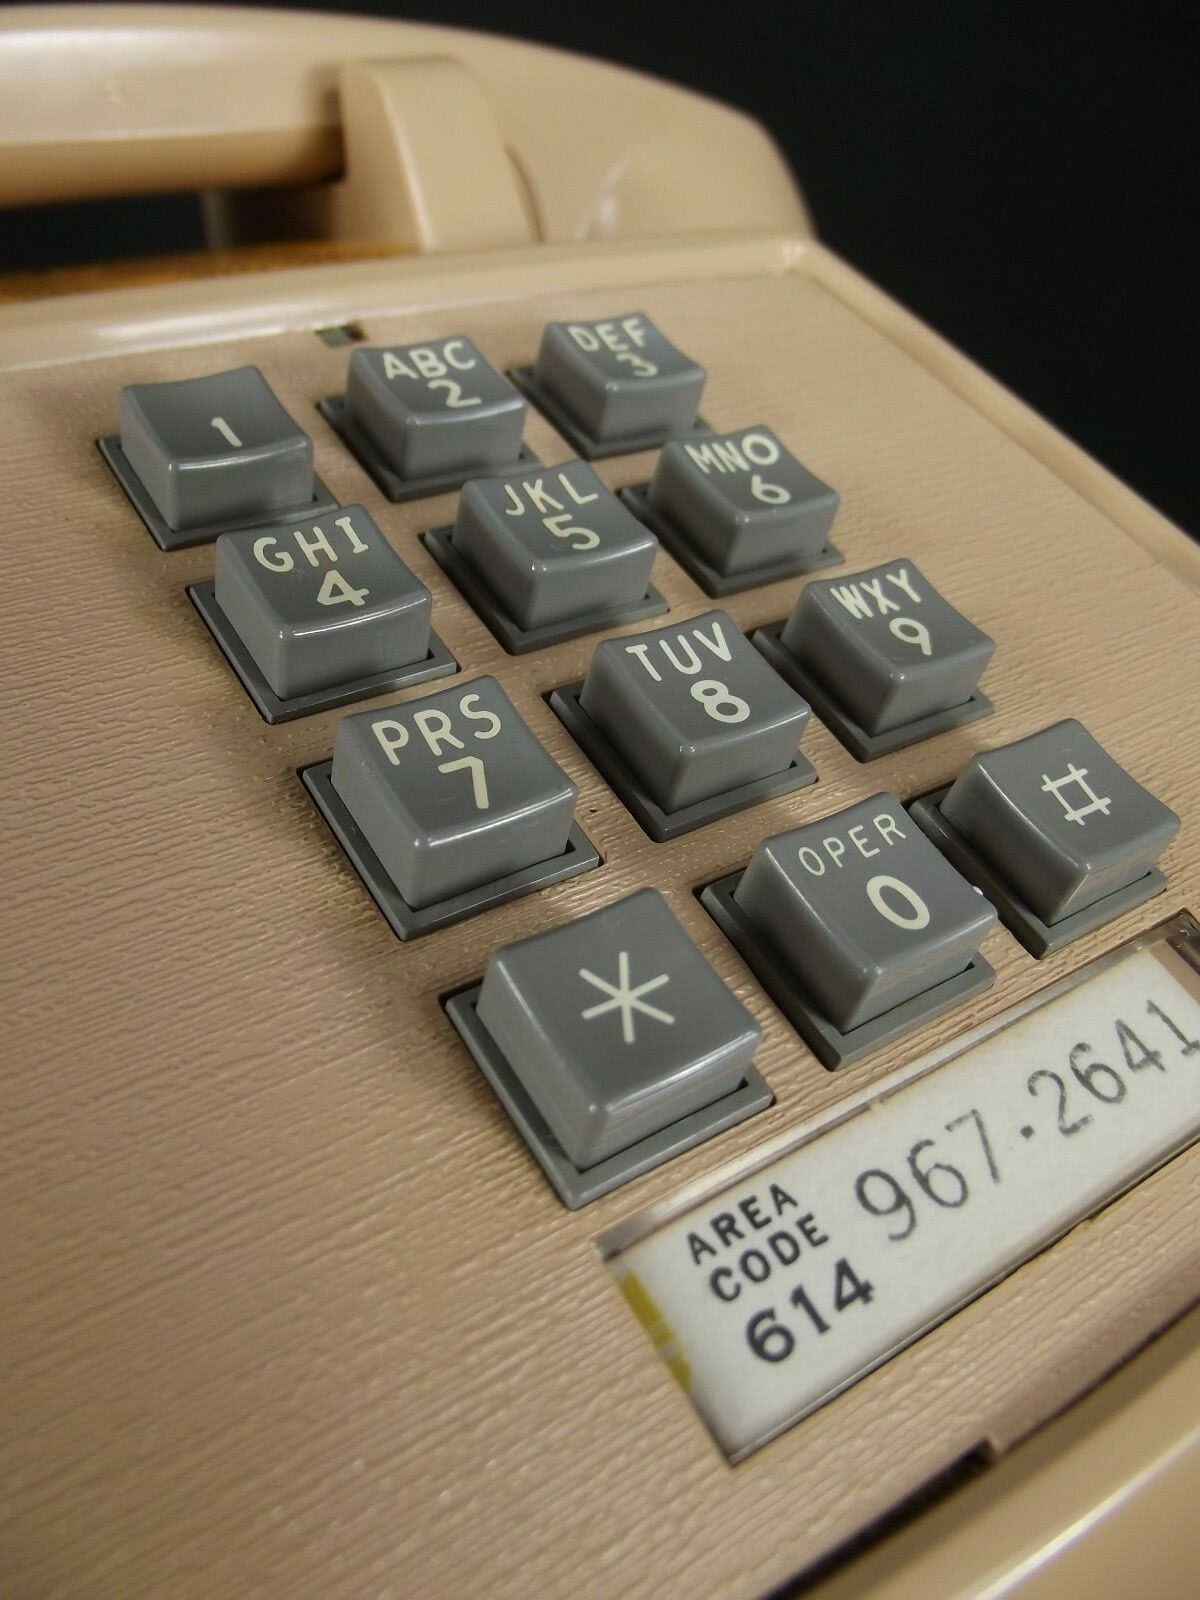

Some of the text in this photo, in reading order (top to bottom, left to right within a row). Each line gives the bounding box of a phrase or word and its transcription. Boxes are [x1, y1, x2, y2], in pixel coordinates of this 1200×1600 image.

[566, 316, 647, 352] DEF
[382, 340, 476, 380] ABC
[614, 351, 658, 378] 3
[427, 378, 481, 407] 2
[211, 416, 242, 449] 1
[685, 434, 780, 474] MNO
[502, 475, 599, 516] JKL
[750, 474, 791, 505] 6
[253, 516, 369, 573] GHI
[541, 513, 599, 551] 5
[316, 569, 368, 607] 4
[829, 568, 923, 620] WXY
[624, 622, 733, 683] TUV
[888, 617, 933, 656] 9
[689, 680, 751, 724] 8
[372, 693, 503, 766] PRS
[438, 756, 490, 810] 7
[798, 813, 906, 876] OPER
[686, 1184, 798, 1264] AREA
[708, 1214, 829, 1303] CODE
[745, 1257, 874, 1364] 614
